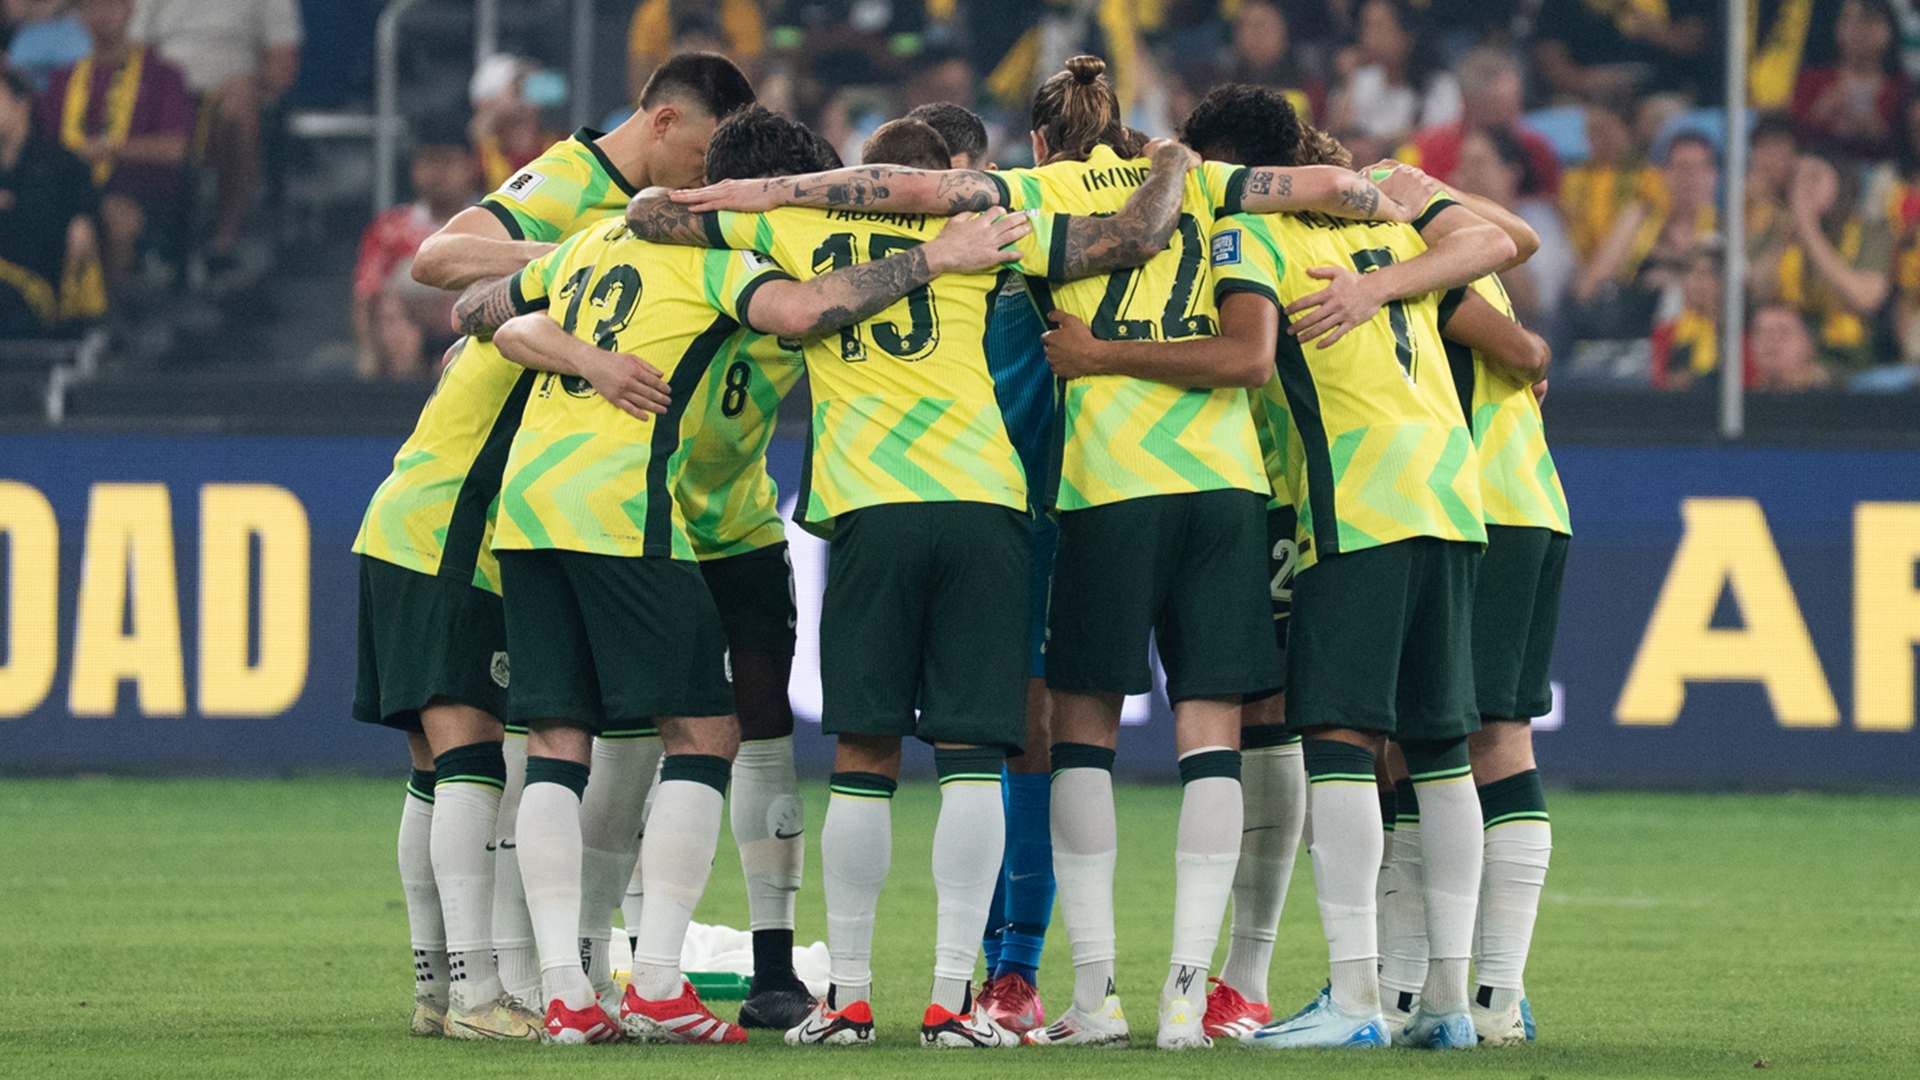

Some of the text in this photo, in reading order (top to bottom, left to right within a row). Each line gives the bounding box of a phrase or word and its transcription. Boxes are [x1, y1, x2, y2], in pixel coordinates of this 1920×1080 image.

[538, 263, 643, 399] 13
[811, 232, 940, 363] 15
[721, 361, 751, 419] 8
